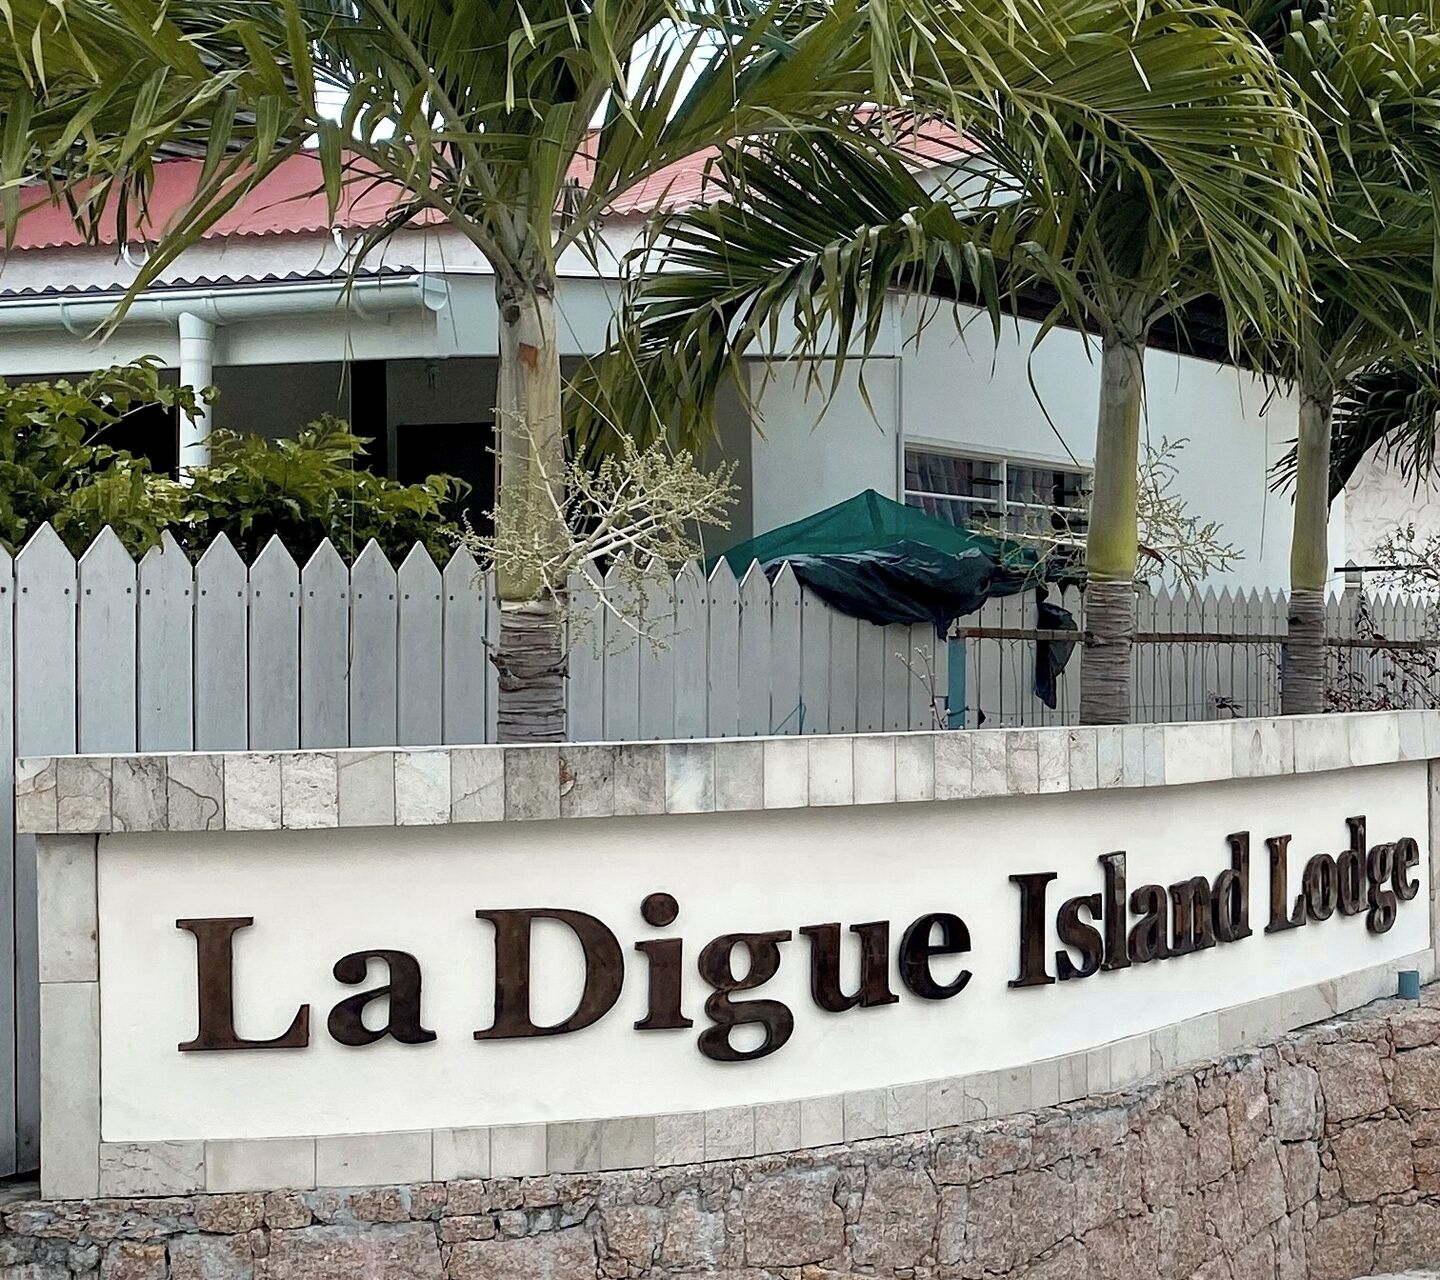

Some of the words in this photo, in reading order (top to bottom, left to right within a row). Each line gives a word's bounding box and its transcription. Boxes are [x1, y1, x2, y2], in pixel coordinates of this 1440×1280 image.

[176, 916, 437, 1053] La
[473, 892, 974, 1063] Digue
[1007, 830, 1253, 989] Island
[1264, 815, 1420, 935] Lodge
